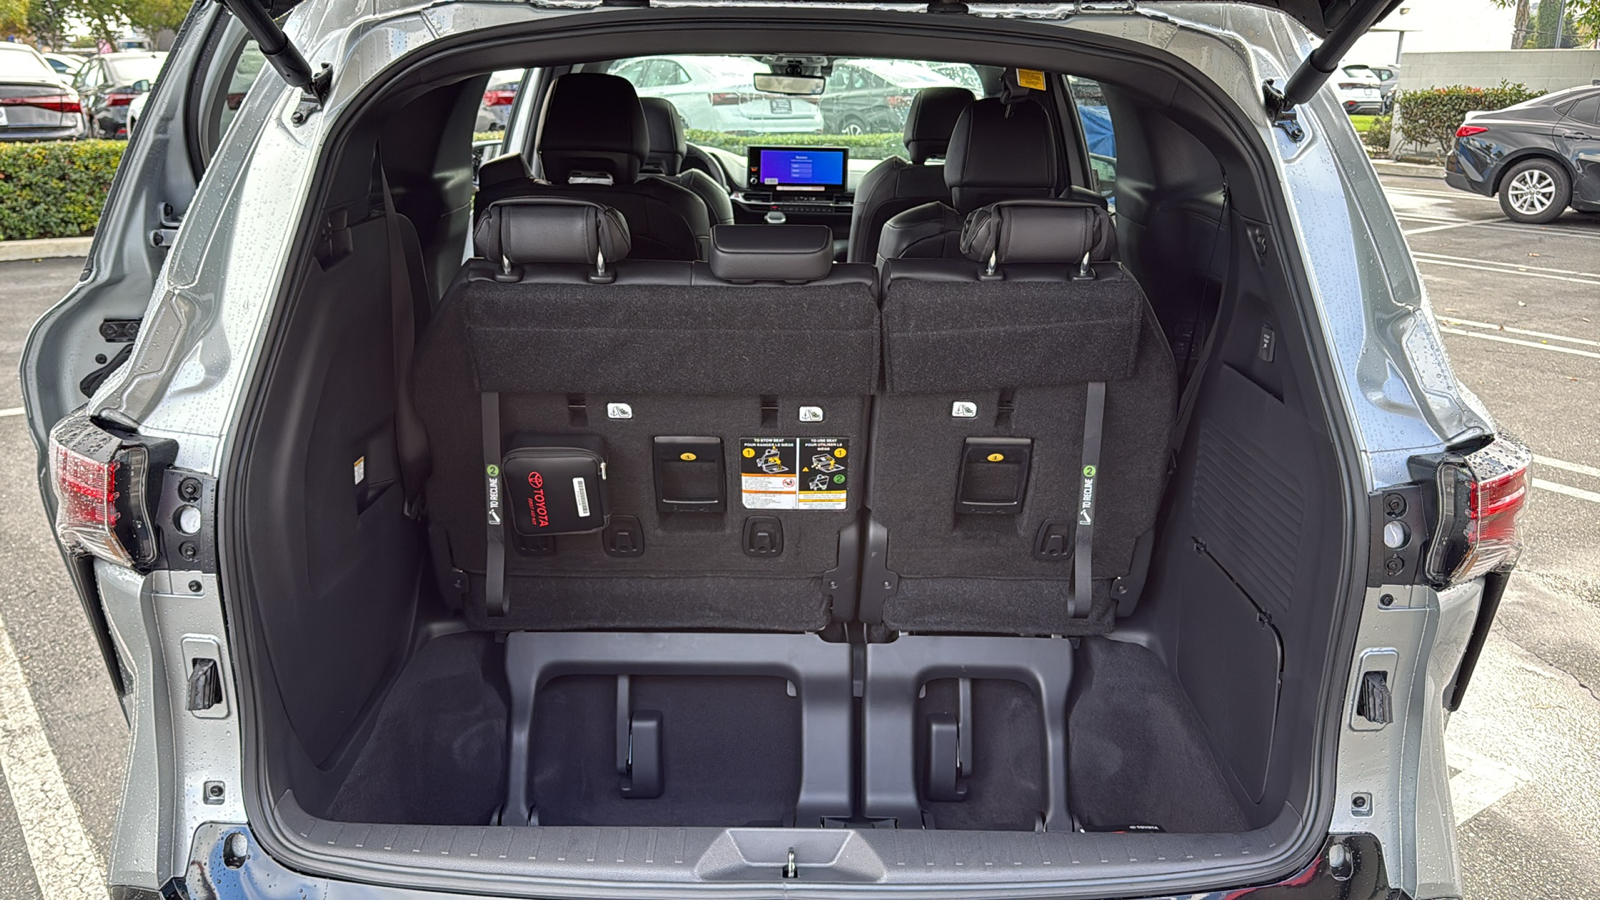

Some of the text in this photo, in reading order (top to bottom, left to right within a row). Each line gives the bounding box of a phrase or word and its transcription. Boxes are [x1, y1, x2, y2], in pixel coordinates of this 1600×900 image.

[489, 477, 499, 500] RECLINE
[1083, 478, 1093, 501] RECLINE
[533, 488, 549, 527] TOYOTA
